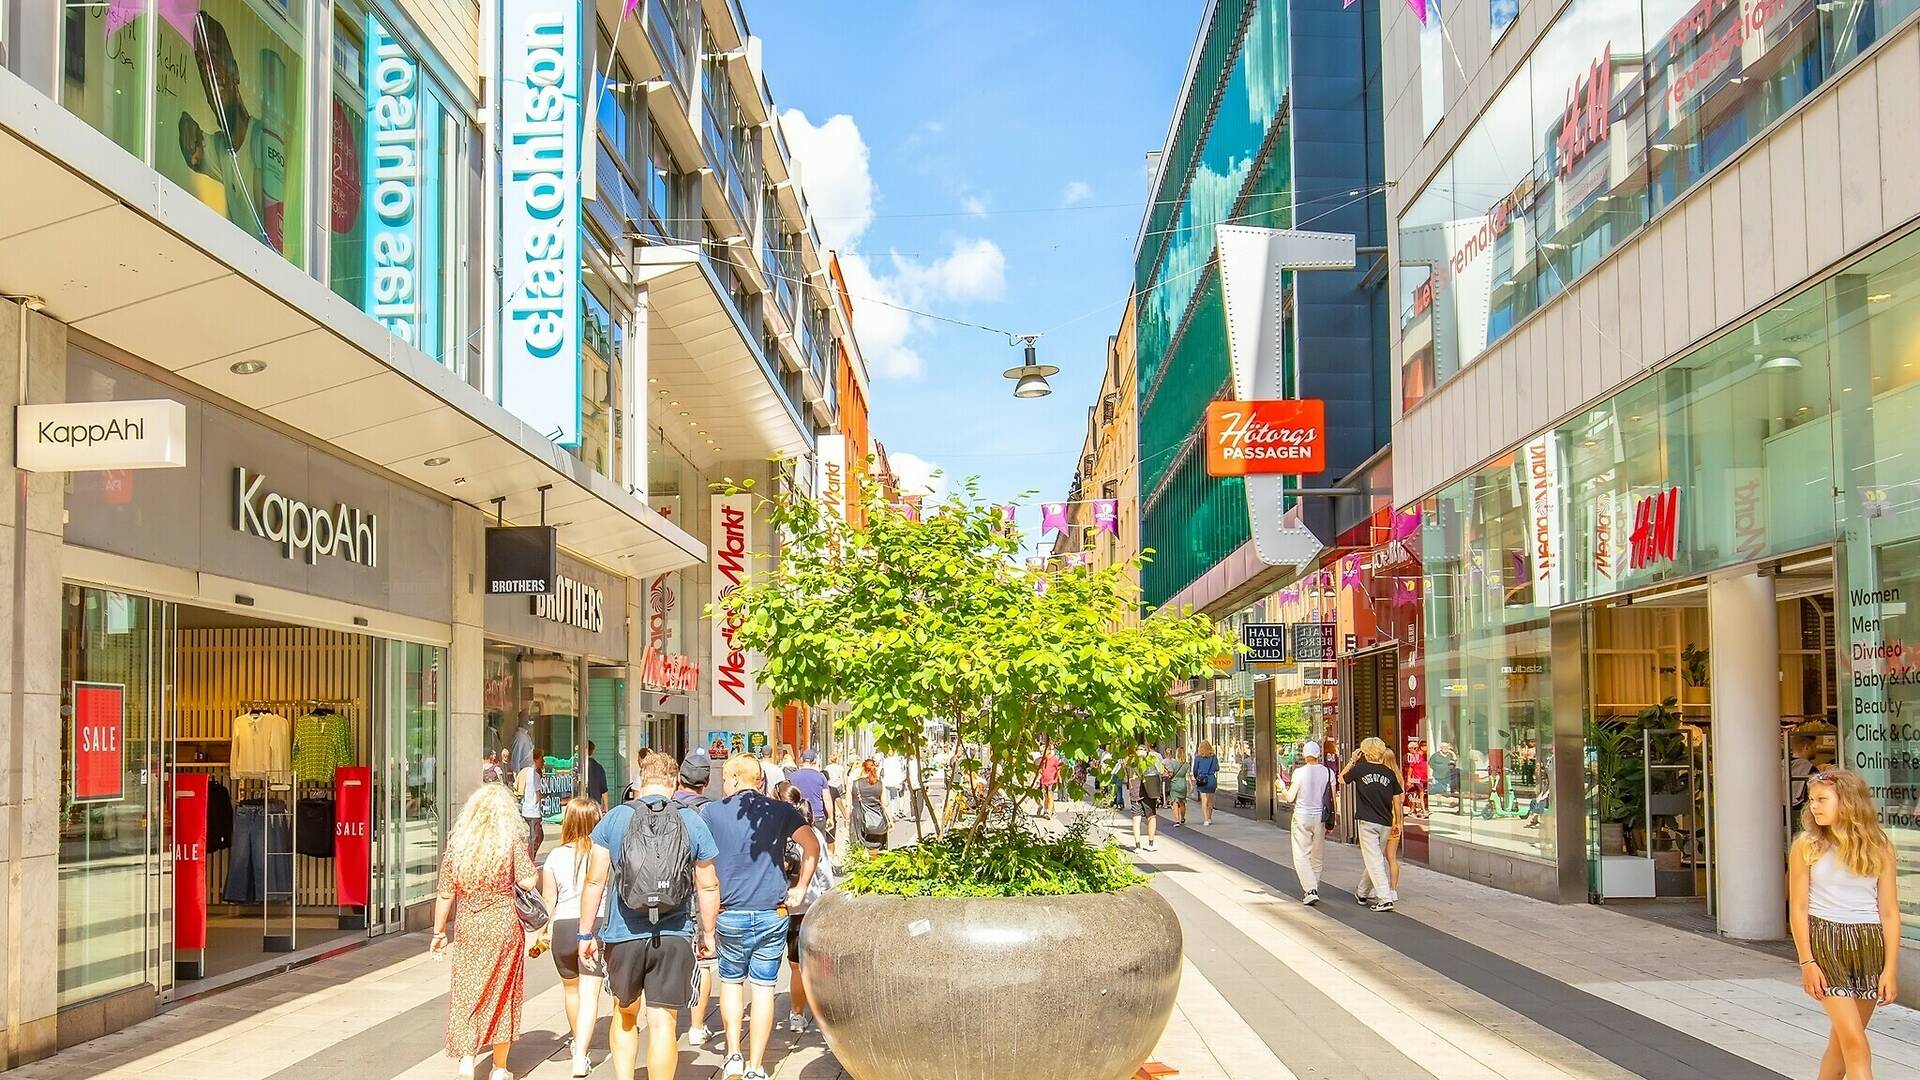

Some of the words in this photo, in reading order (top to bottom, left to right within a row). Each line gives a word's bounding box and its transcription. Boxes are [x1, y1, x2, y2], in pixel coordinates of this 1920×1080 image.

[512, 12, 565, 220] ohlson
[1449, 199, 1509, 281] remake
[512, 226, 565, 358] clas
[38, 417, 144, 447] KappAhl
[1218, 411, 1318, 448] Hötorgs
[1223, 446, 1312, 460] PASSAGEN
[822, 461, 841, 519] Markt
[233, 466, 377, 567] KappAhl
[1629, 486, 1680, 570] H&M
[717, 505, 745, 586] Markt
[491, 579, 546, 593] BROTHERS
[1851, 588, 1900, 607] Women
[1249, 628, 1279, 637] HALL
[1852, 616, 1880, 634] Men
[1249, 638, 1279, 647] BERG
[1853, 639, 1902, 661] Divided
[718, 608, 746, 706] Media
[1249, 649, 1281, 658] GULD
[1854, 669, 1887, 691] Baby
[1889, 667, 1899, 685] &
[1854, 697, 1902, 718] Beauty
[83, 726, 117, 752] SALE
[1855, 723, 1887, 742] Click
[1889, 723, 1900, 742] &
[1856, 751, 1899, 769] Online
[1868, 784, 1917, 801] arment
[336, 822, 365, 836] SALE
[657, 880, 670, 889] HH
